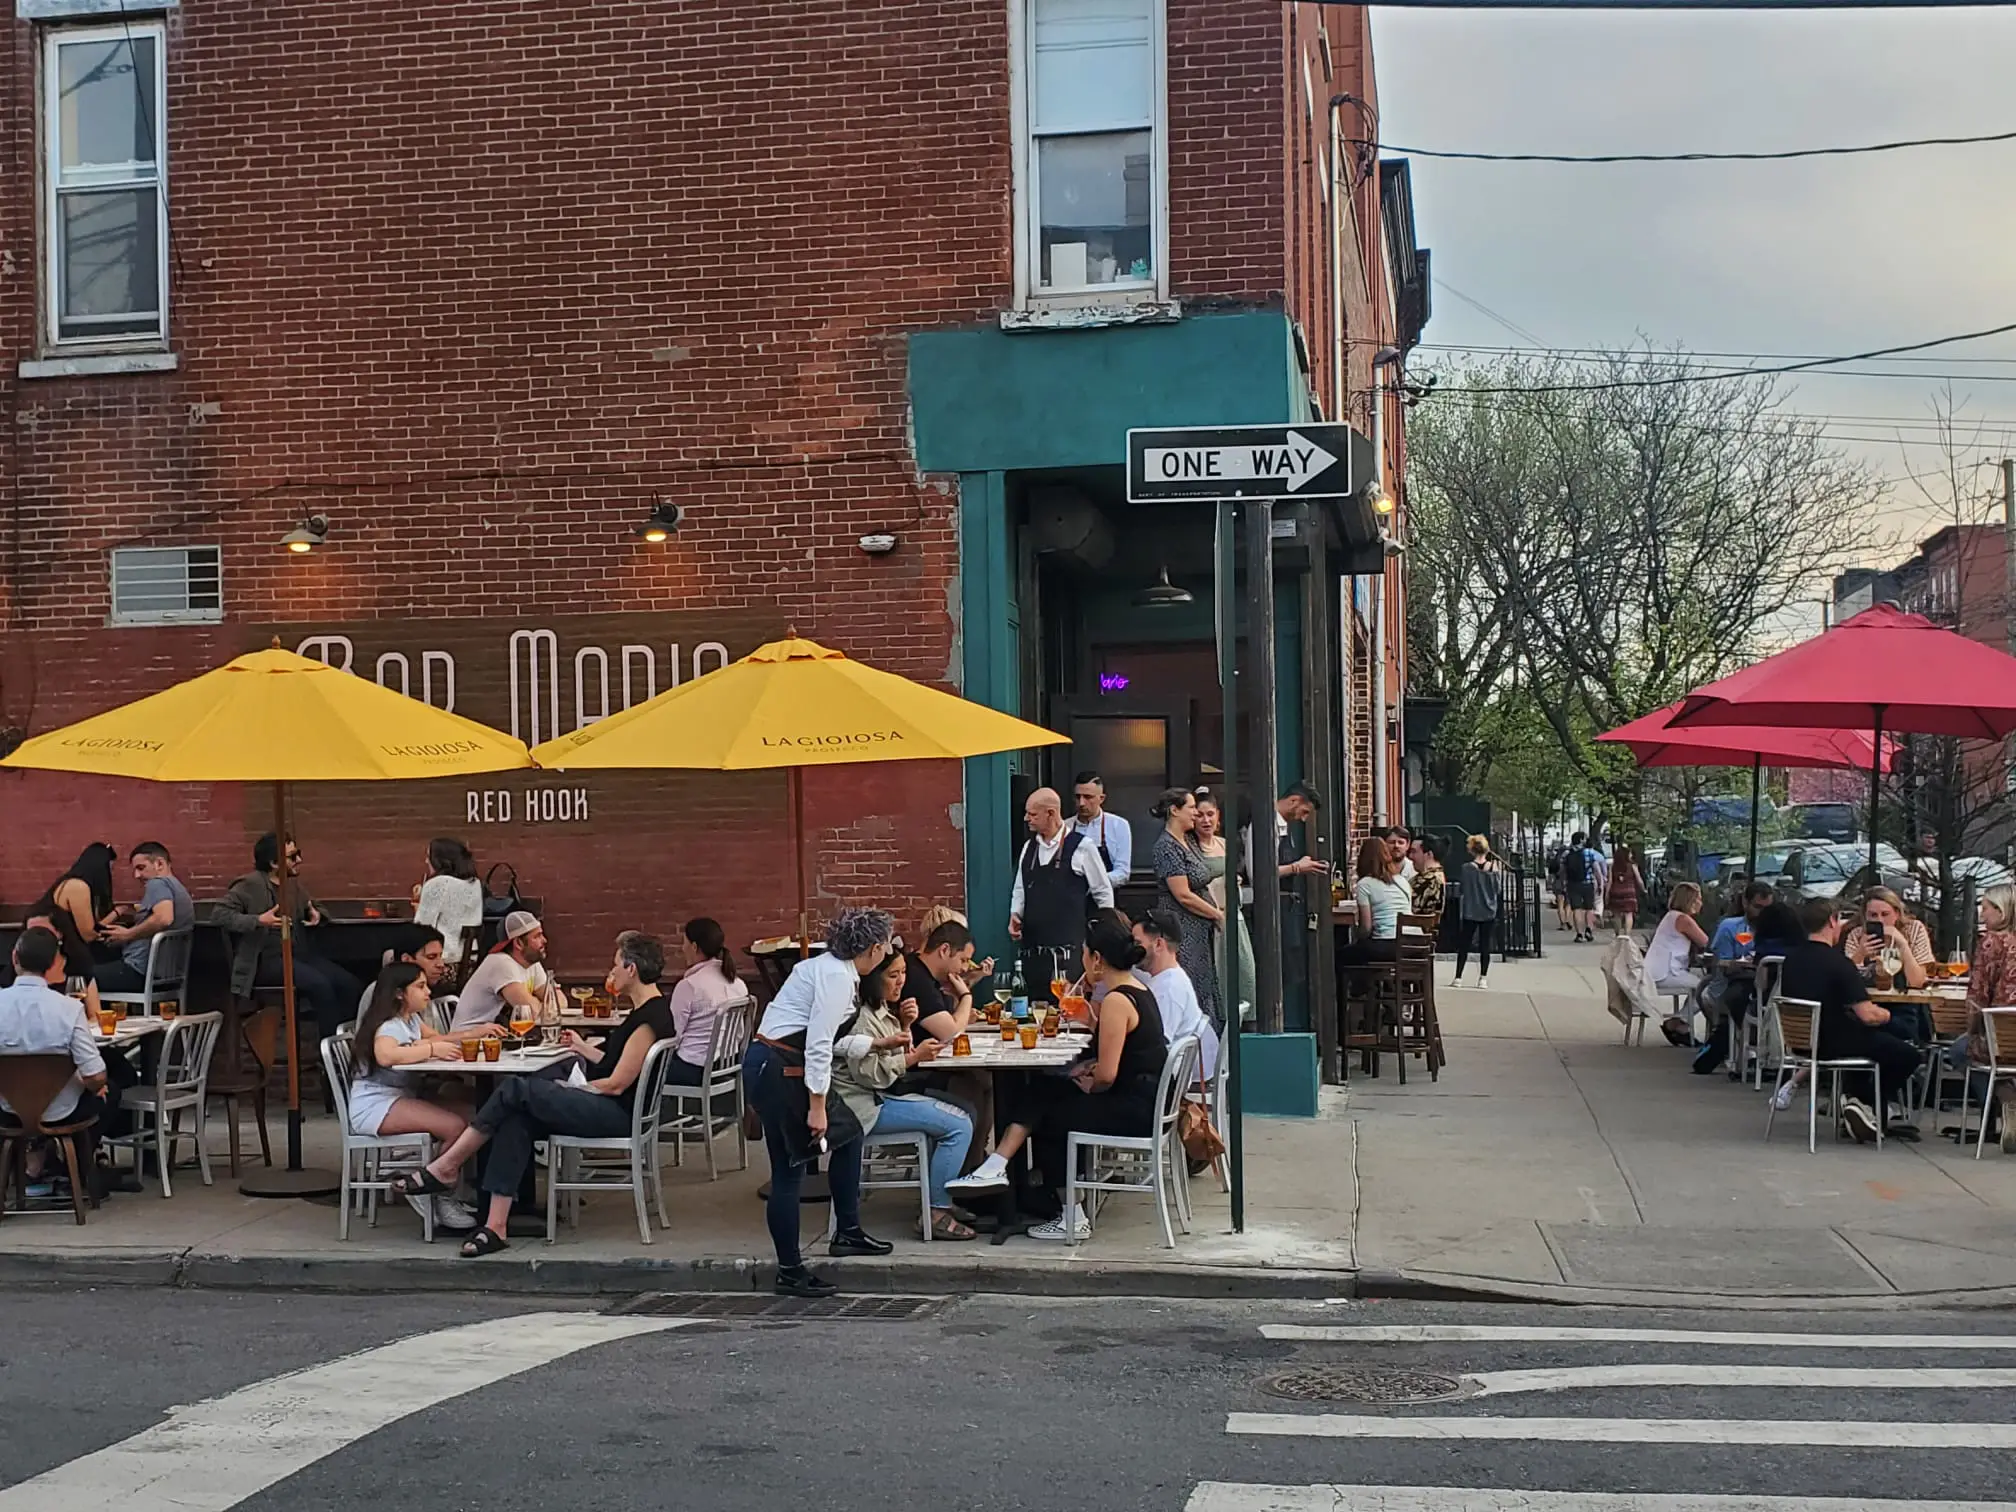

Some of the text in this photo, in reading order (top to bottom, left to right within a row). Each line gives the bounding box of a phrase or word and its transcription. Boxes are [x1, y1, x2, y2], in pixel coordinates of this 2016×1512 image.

[1161, 448, 1315, 478] ONE WAY
[467, 788, 588, 822] RED HOOK
